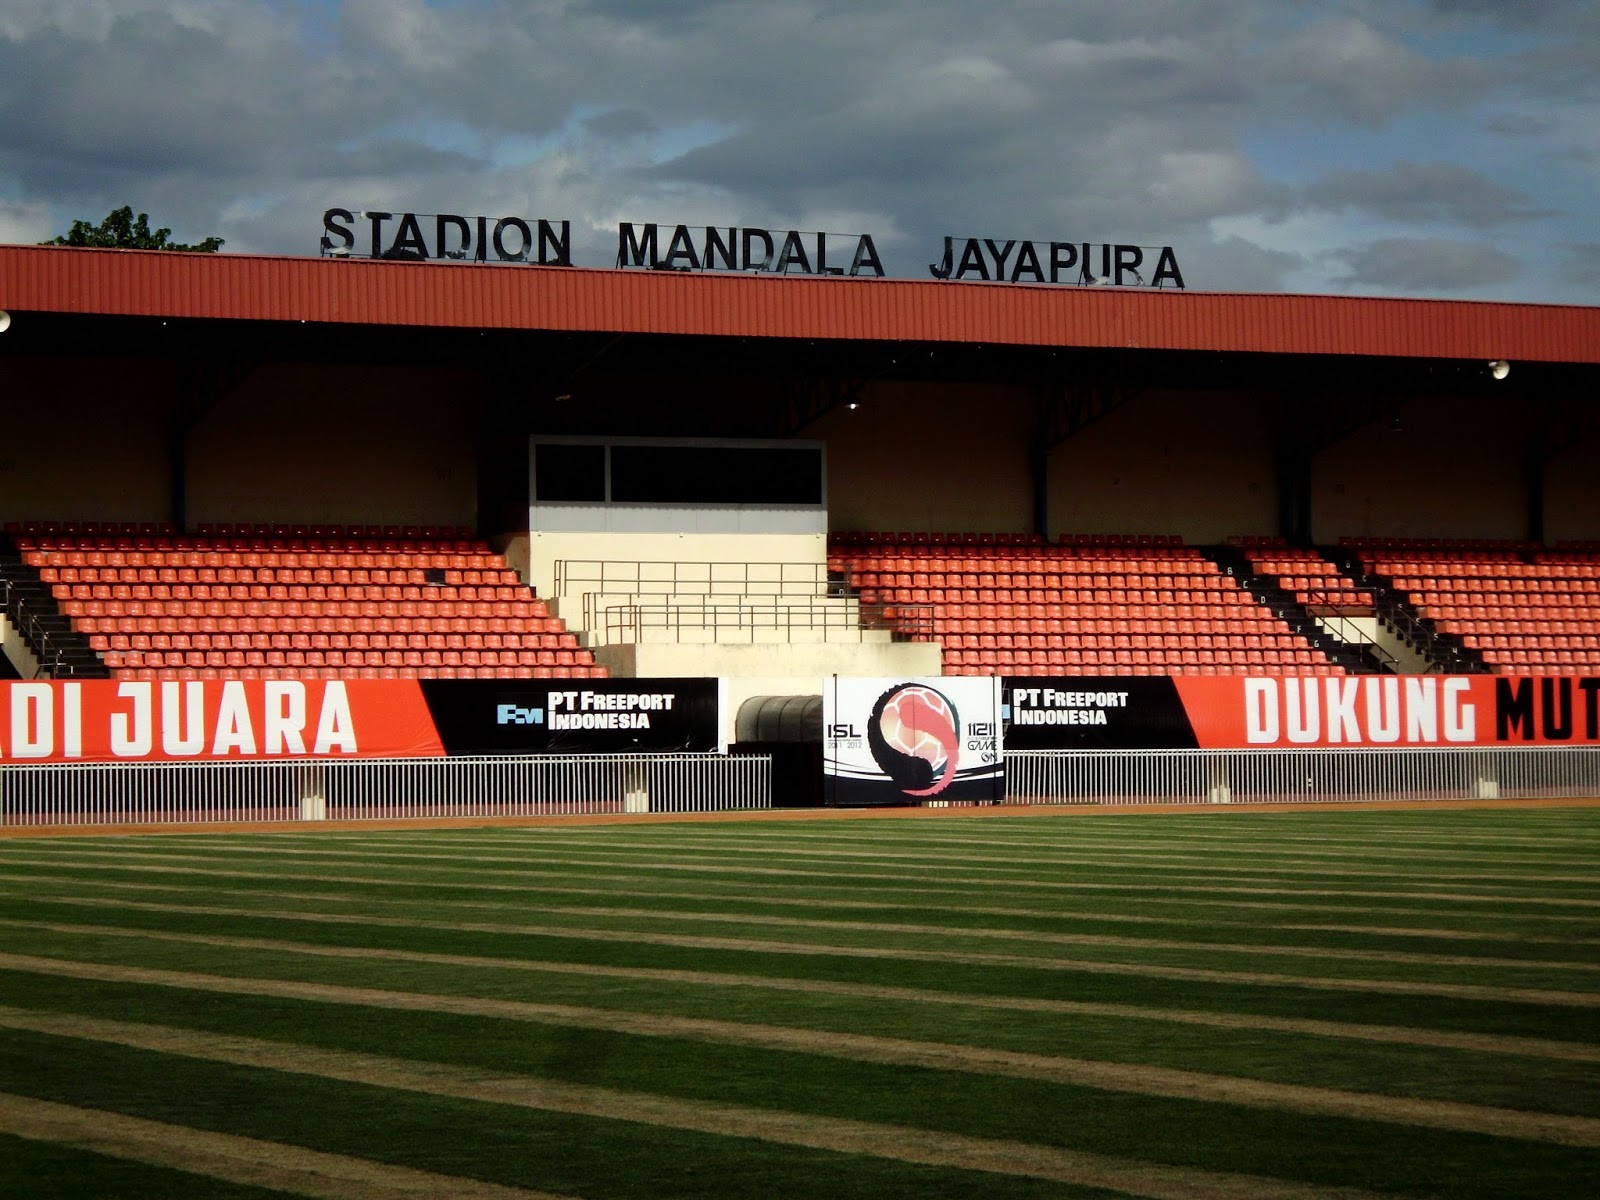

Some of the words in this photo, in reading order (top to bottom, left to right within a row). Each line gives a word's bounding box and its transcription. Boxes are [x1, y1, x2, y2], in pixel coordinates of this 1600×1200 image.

[323, 208, 571, 266] STADION
[619, 222, 885, 277] MANDALA
[929, 236, 1185, 289] JAYAPURA
[547, 691, 578, 711] PT
[580, 690, 675, 710] FREEPORT
[1013, 689, 1041, 707] PT
[1043, 688, 1129, 707] FREEPORT
[0, 682, 82, 758] DI
[110, 680, 359, 756] JUARA
[1013, 706, 1108, 725] INDONESIA
[1244, 677, 1476, 744] DUKUNG
[1495, 676, 1600, 741] MUT
[547, 711, 651, 730] INDONESIA
[827, 724, 862, 738] ISL
